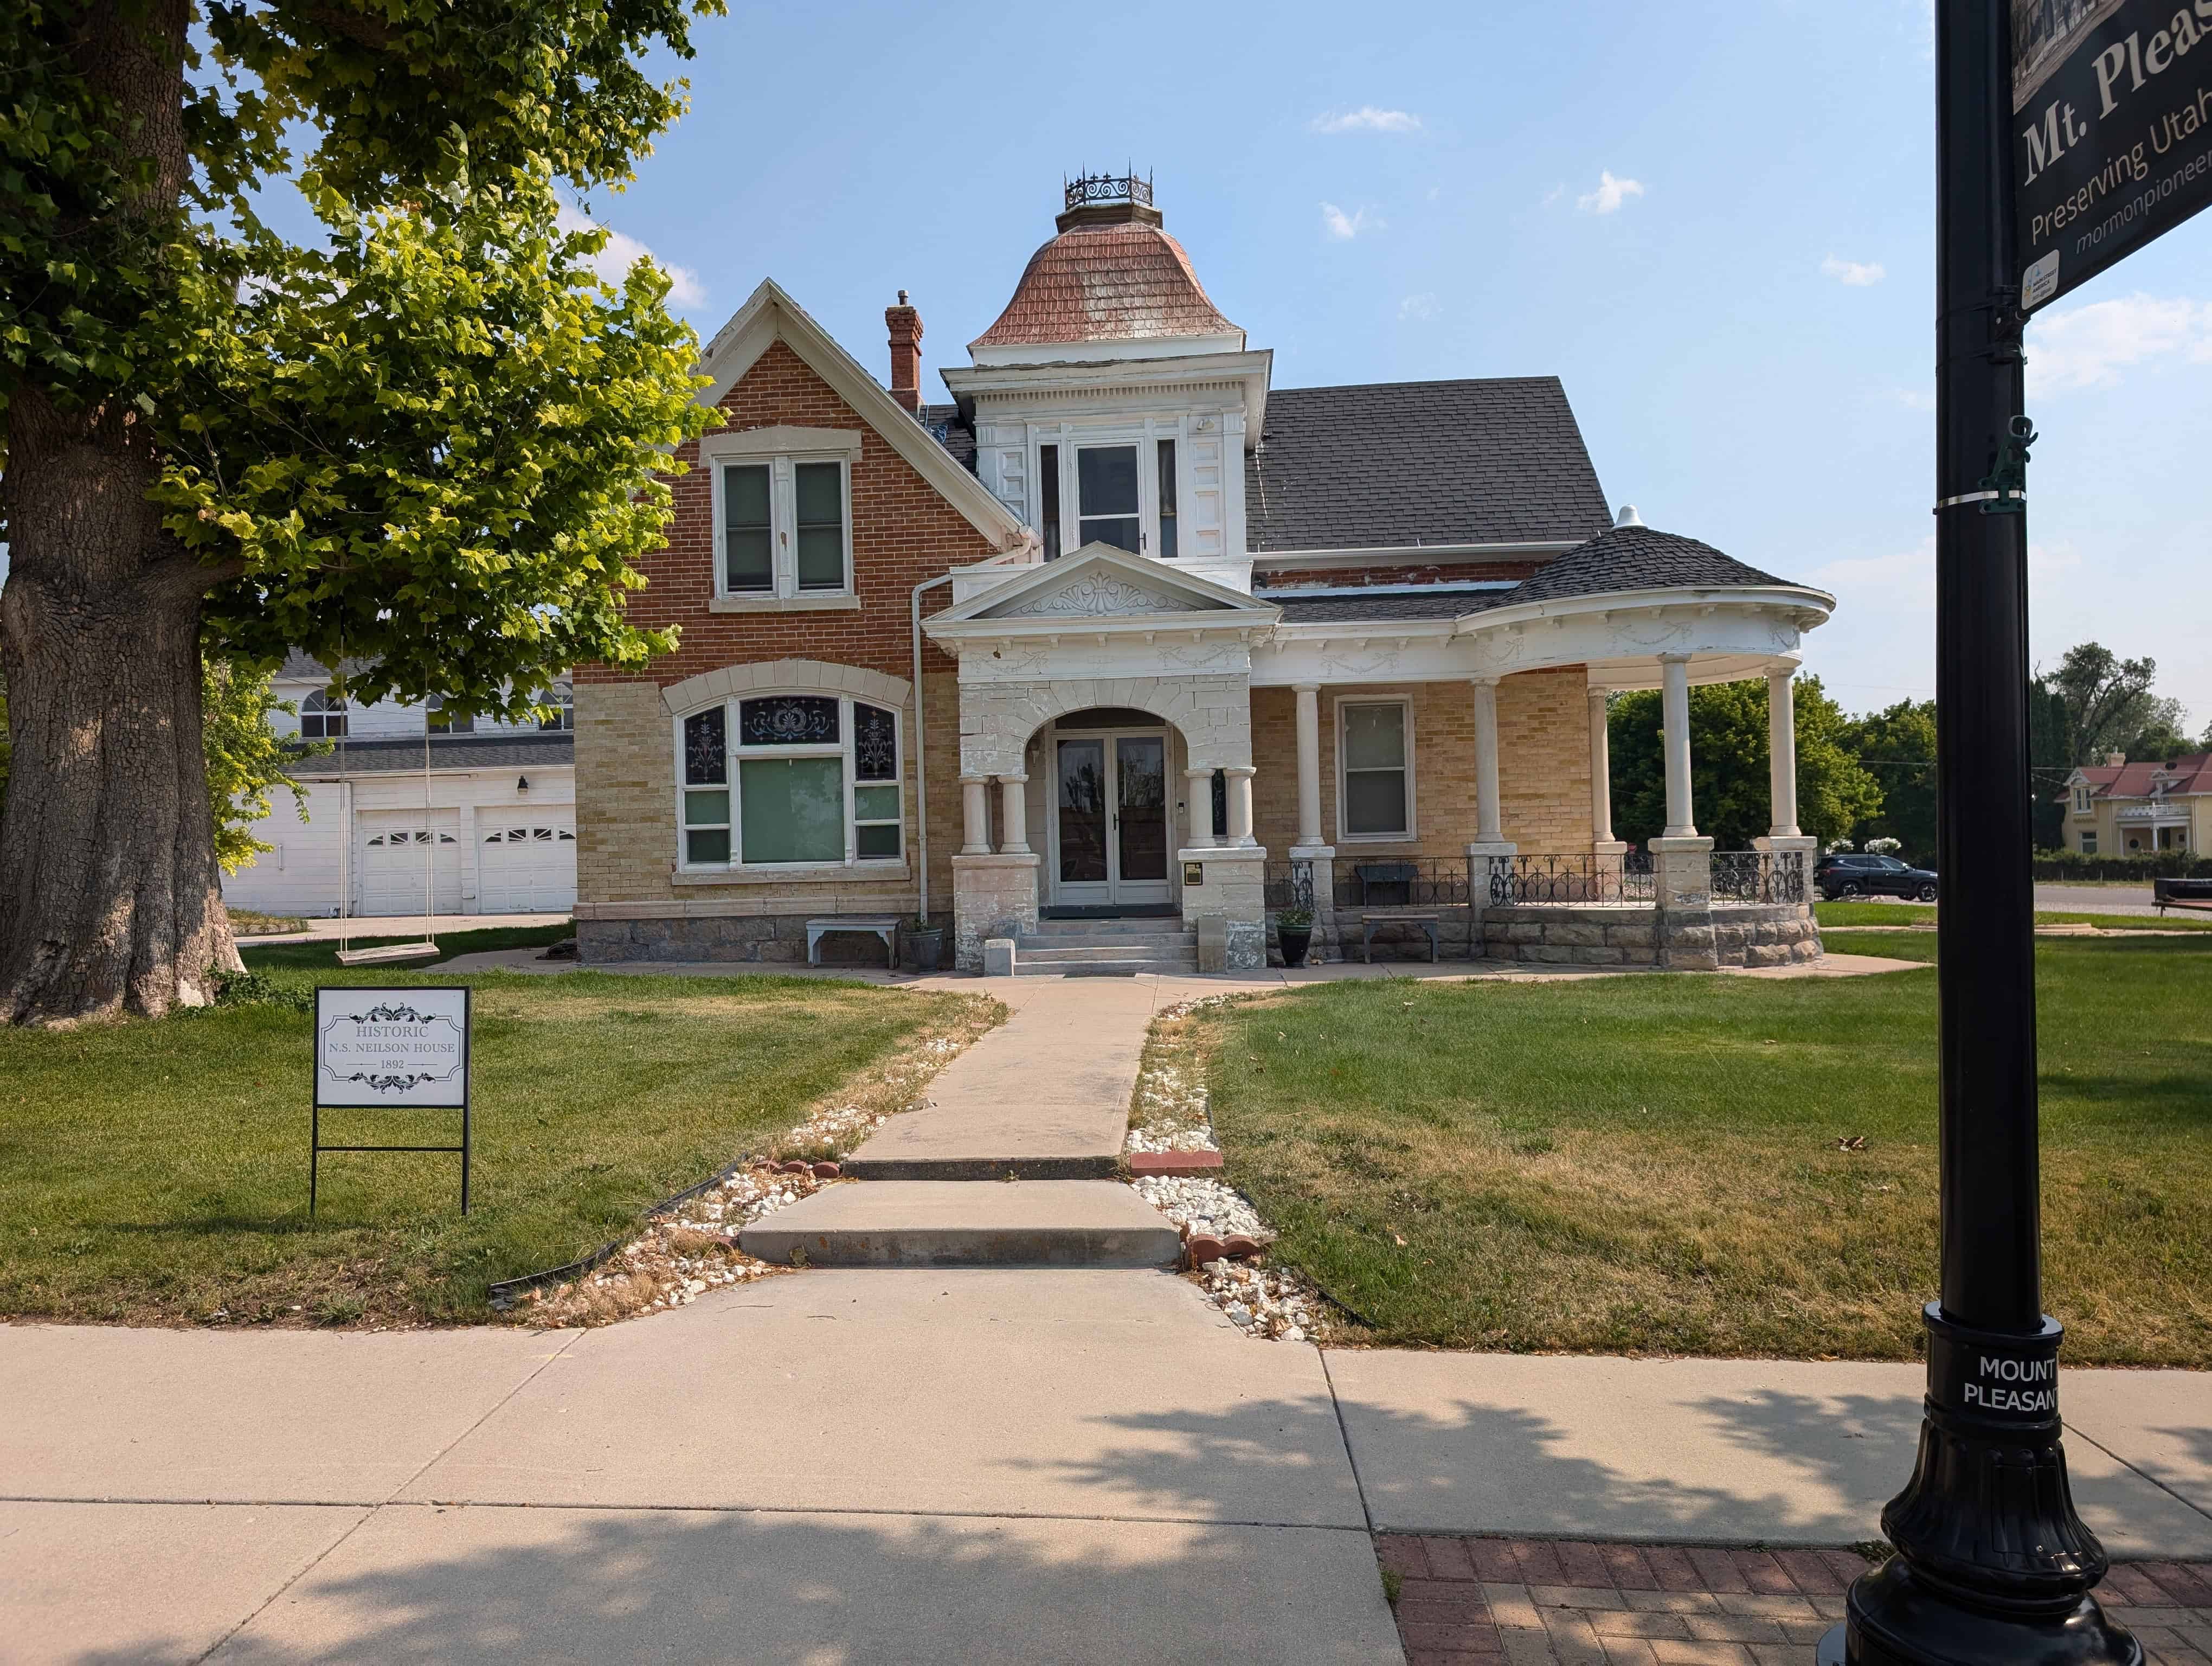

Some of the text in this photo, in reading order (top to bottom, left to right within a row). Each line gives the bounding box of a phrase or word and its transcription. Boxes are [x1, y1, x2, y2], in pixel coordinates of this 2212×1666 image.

[2023, 100, 2087, 187] Mt.
[2032, 142, 2149, 246] Preserving
[356, 1026, 428, 1037] HISTORIC
[329, 1043, 455, 1053] N.S. NEILSON HOUSE
[381, 1060, 404, 1069] 1892
[1980, 1356, 2055, 1382] MOUNT
